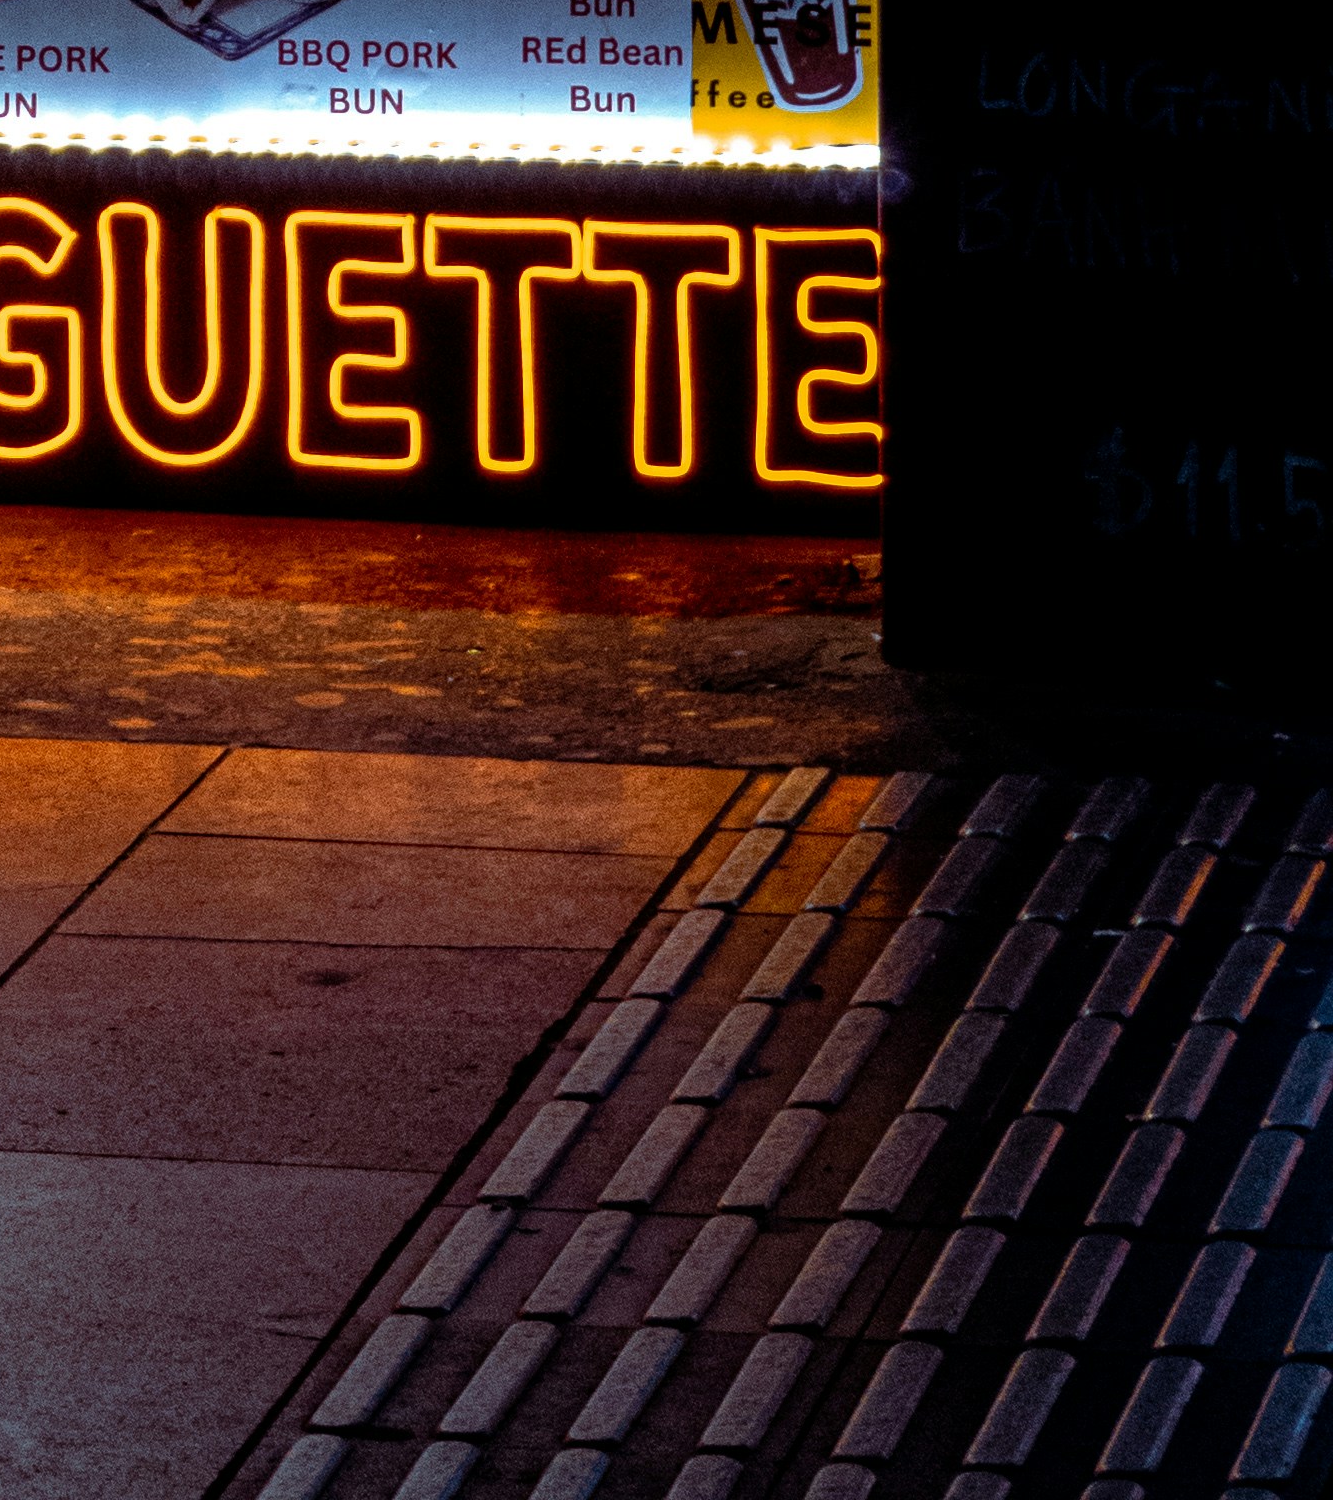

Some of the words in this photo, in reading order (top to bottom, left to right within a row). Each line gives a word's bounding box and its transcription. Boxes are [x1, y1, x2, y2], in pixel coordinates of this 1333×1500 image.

[17, 46, 110, 73] PORK
[277, 40, 351, 71] BBQ
[362, 41, 457, 70] PORK
[521, 37, 587, 65] REd
[599, 39, 684, 66] Bean
[329, 88, 404, 115] BUN
[570, 87, 636, 113] Bun
